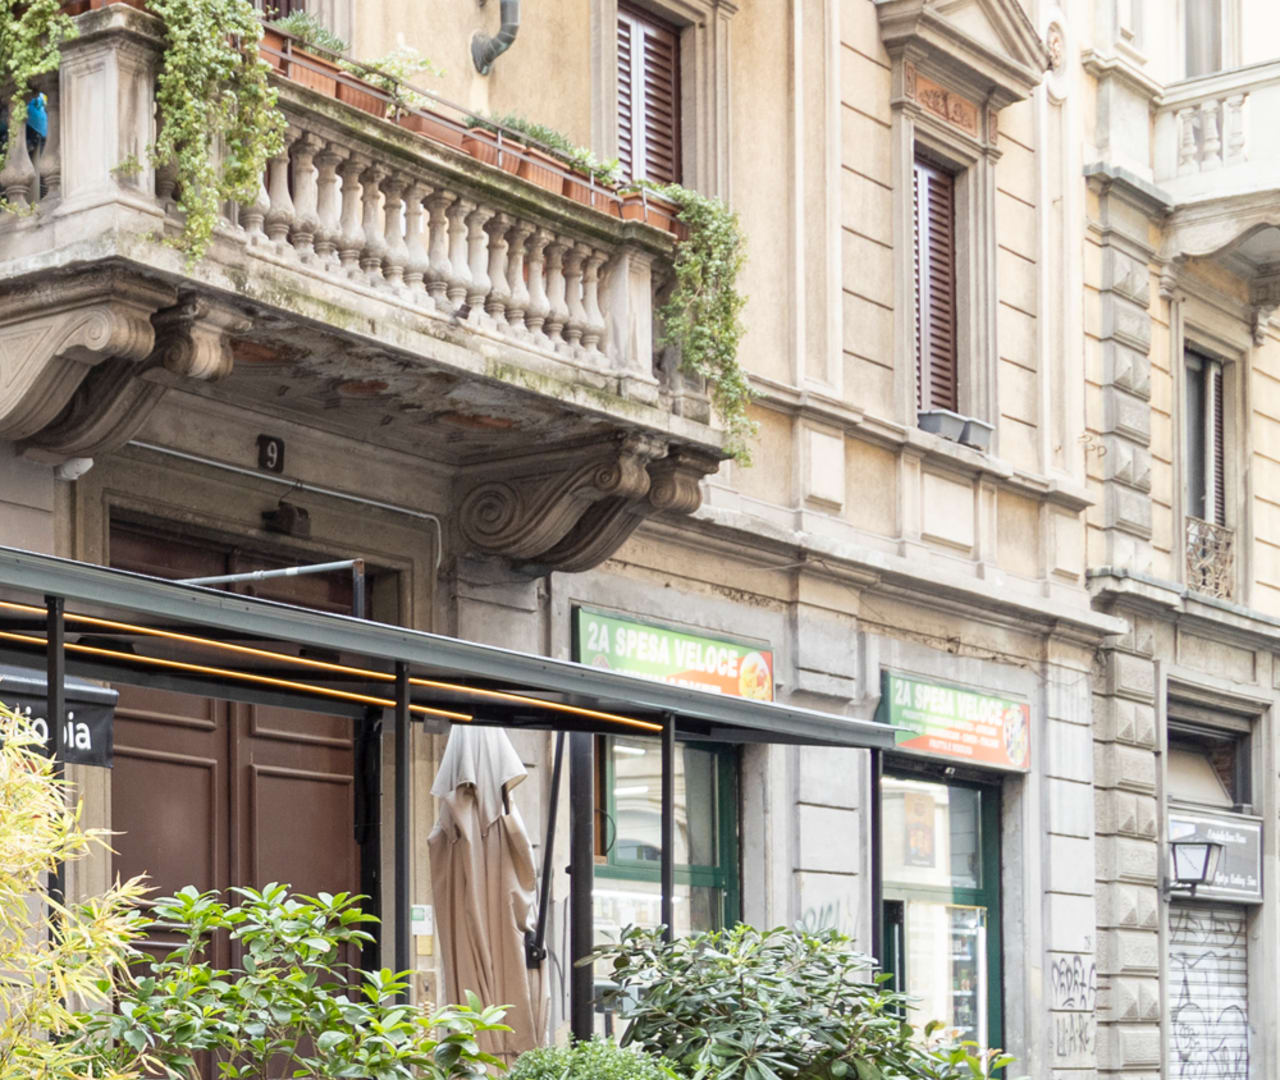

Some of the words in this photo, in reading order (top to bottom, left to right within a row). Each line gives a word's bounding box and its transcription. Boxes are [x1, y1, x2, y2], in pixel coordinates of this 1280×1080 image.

[266, 441, 278, 468] 9
[588, 621, 610, 653] 2A
[616, 627, 669, 665] SPESA
[674, 638, 738, 678] VELOCE
[915, 684, 955, 717] SPESA
[958, 692, 1003, 726] VELOCE
